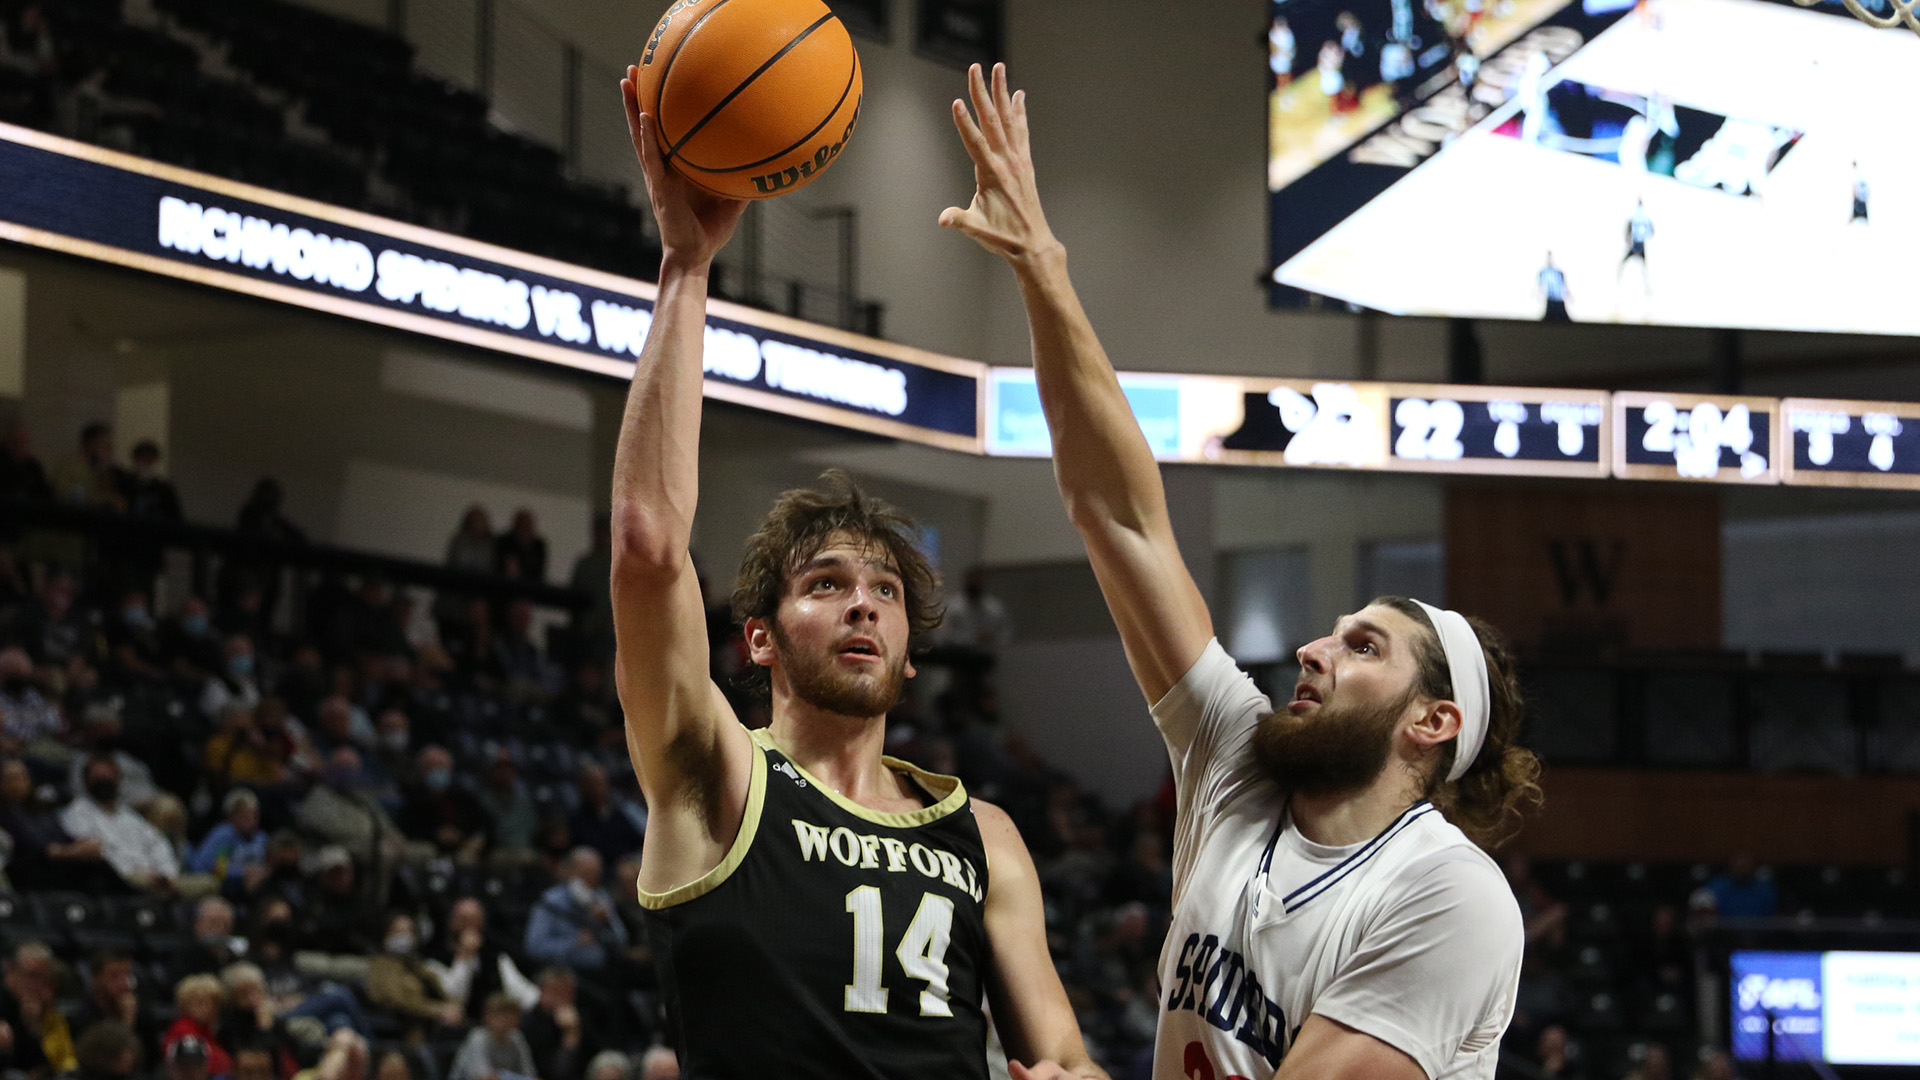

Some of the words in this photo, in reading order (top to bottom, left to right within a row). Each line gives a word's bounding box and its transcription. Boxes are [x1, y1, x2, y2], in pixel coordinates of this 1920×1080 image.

[159, 196, 374, 291] RICHMOND
[376, 250, 530, 329] SPIDERS
[531, 286, 591, 343] VS.
[1395, 398, 1464, 460] 22
[1643, 401, 1753, 454] 2:04
[844, 885, 955, 1017] 14
[1168, 932, 1301, 1071] SPIDER
